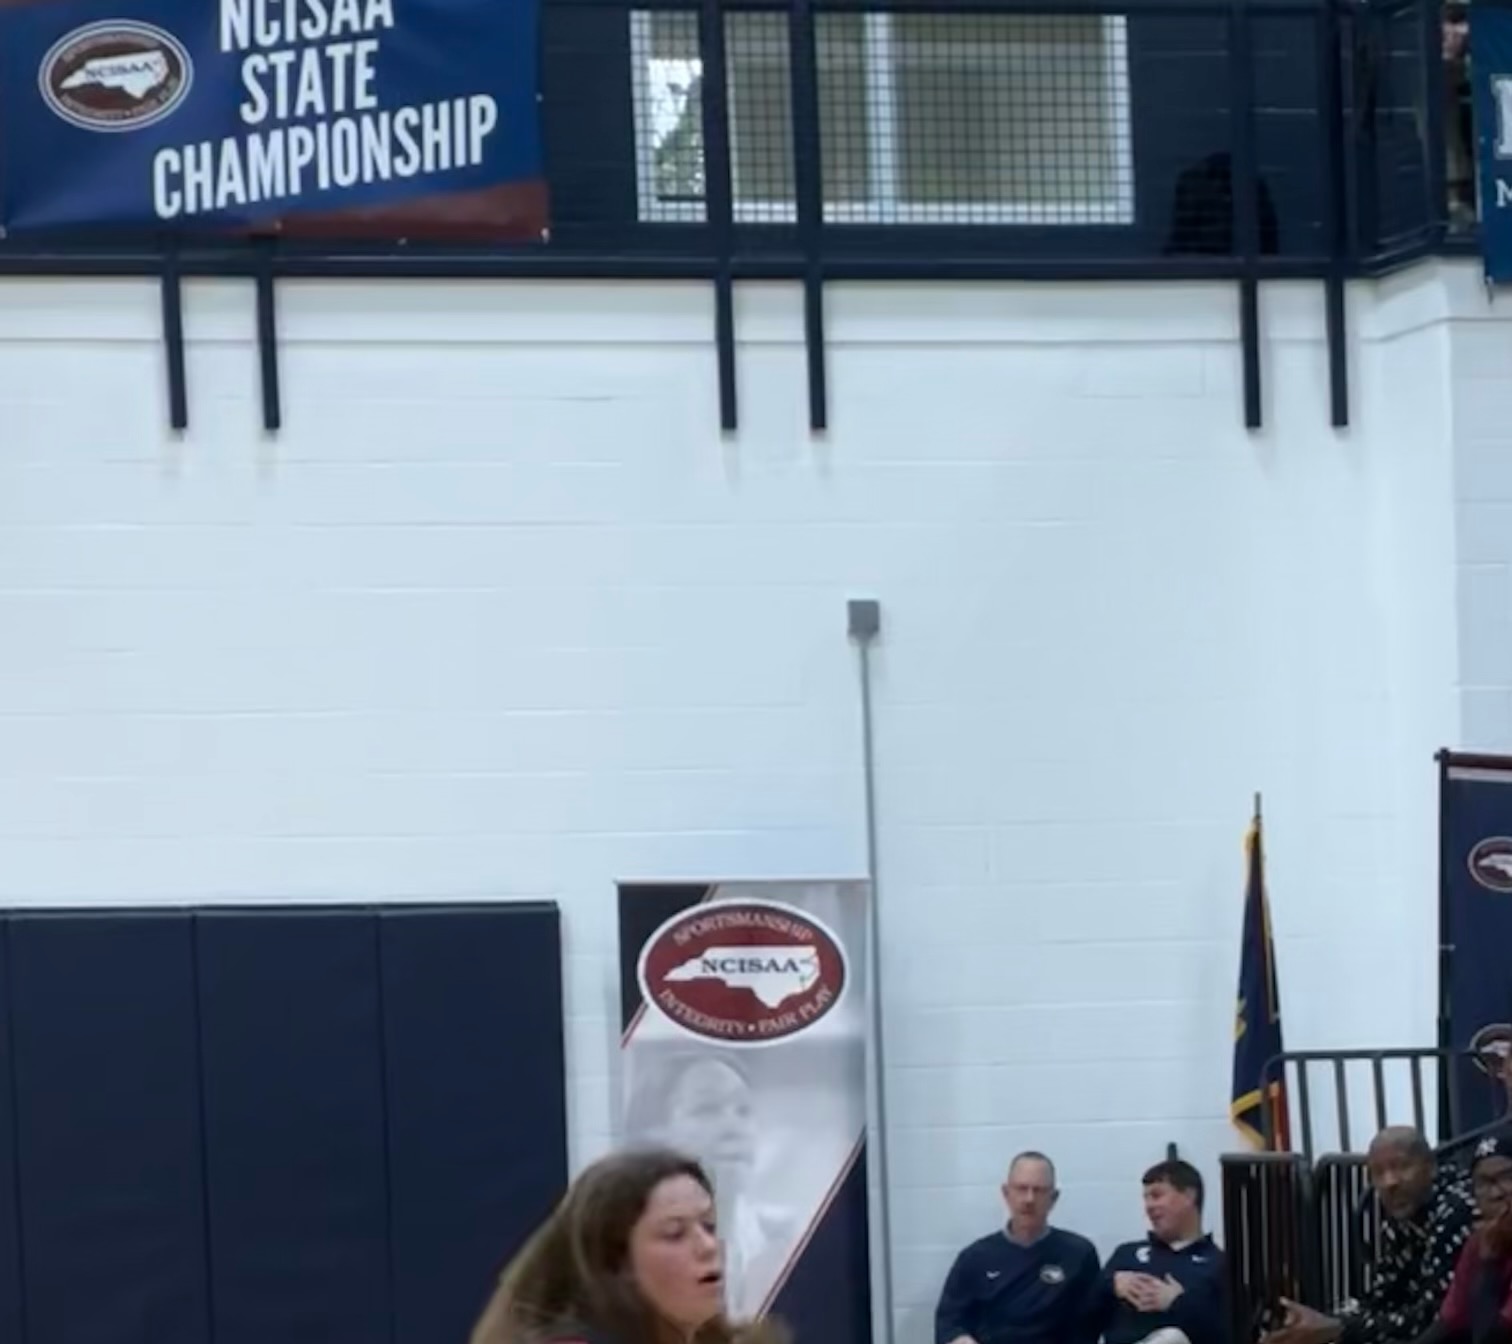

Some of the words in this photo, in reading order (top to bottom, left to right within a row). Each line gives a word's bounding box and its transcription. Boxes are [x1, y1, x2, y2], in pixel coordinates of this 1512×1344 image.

[239, 39, 378, 124] STATE
[153, 95, 498, 219] CHAMPIONSHIP
[672, 910, 814, 946] SPORTSMANSHIP
[701, 957, 800, 975] NCISAA
